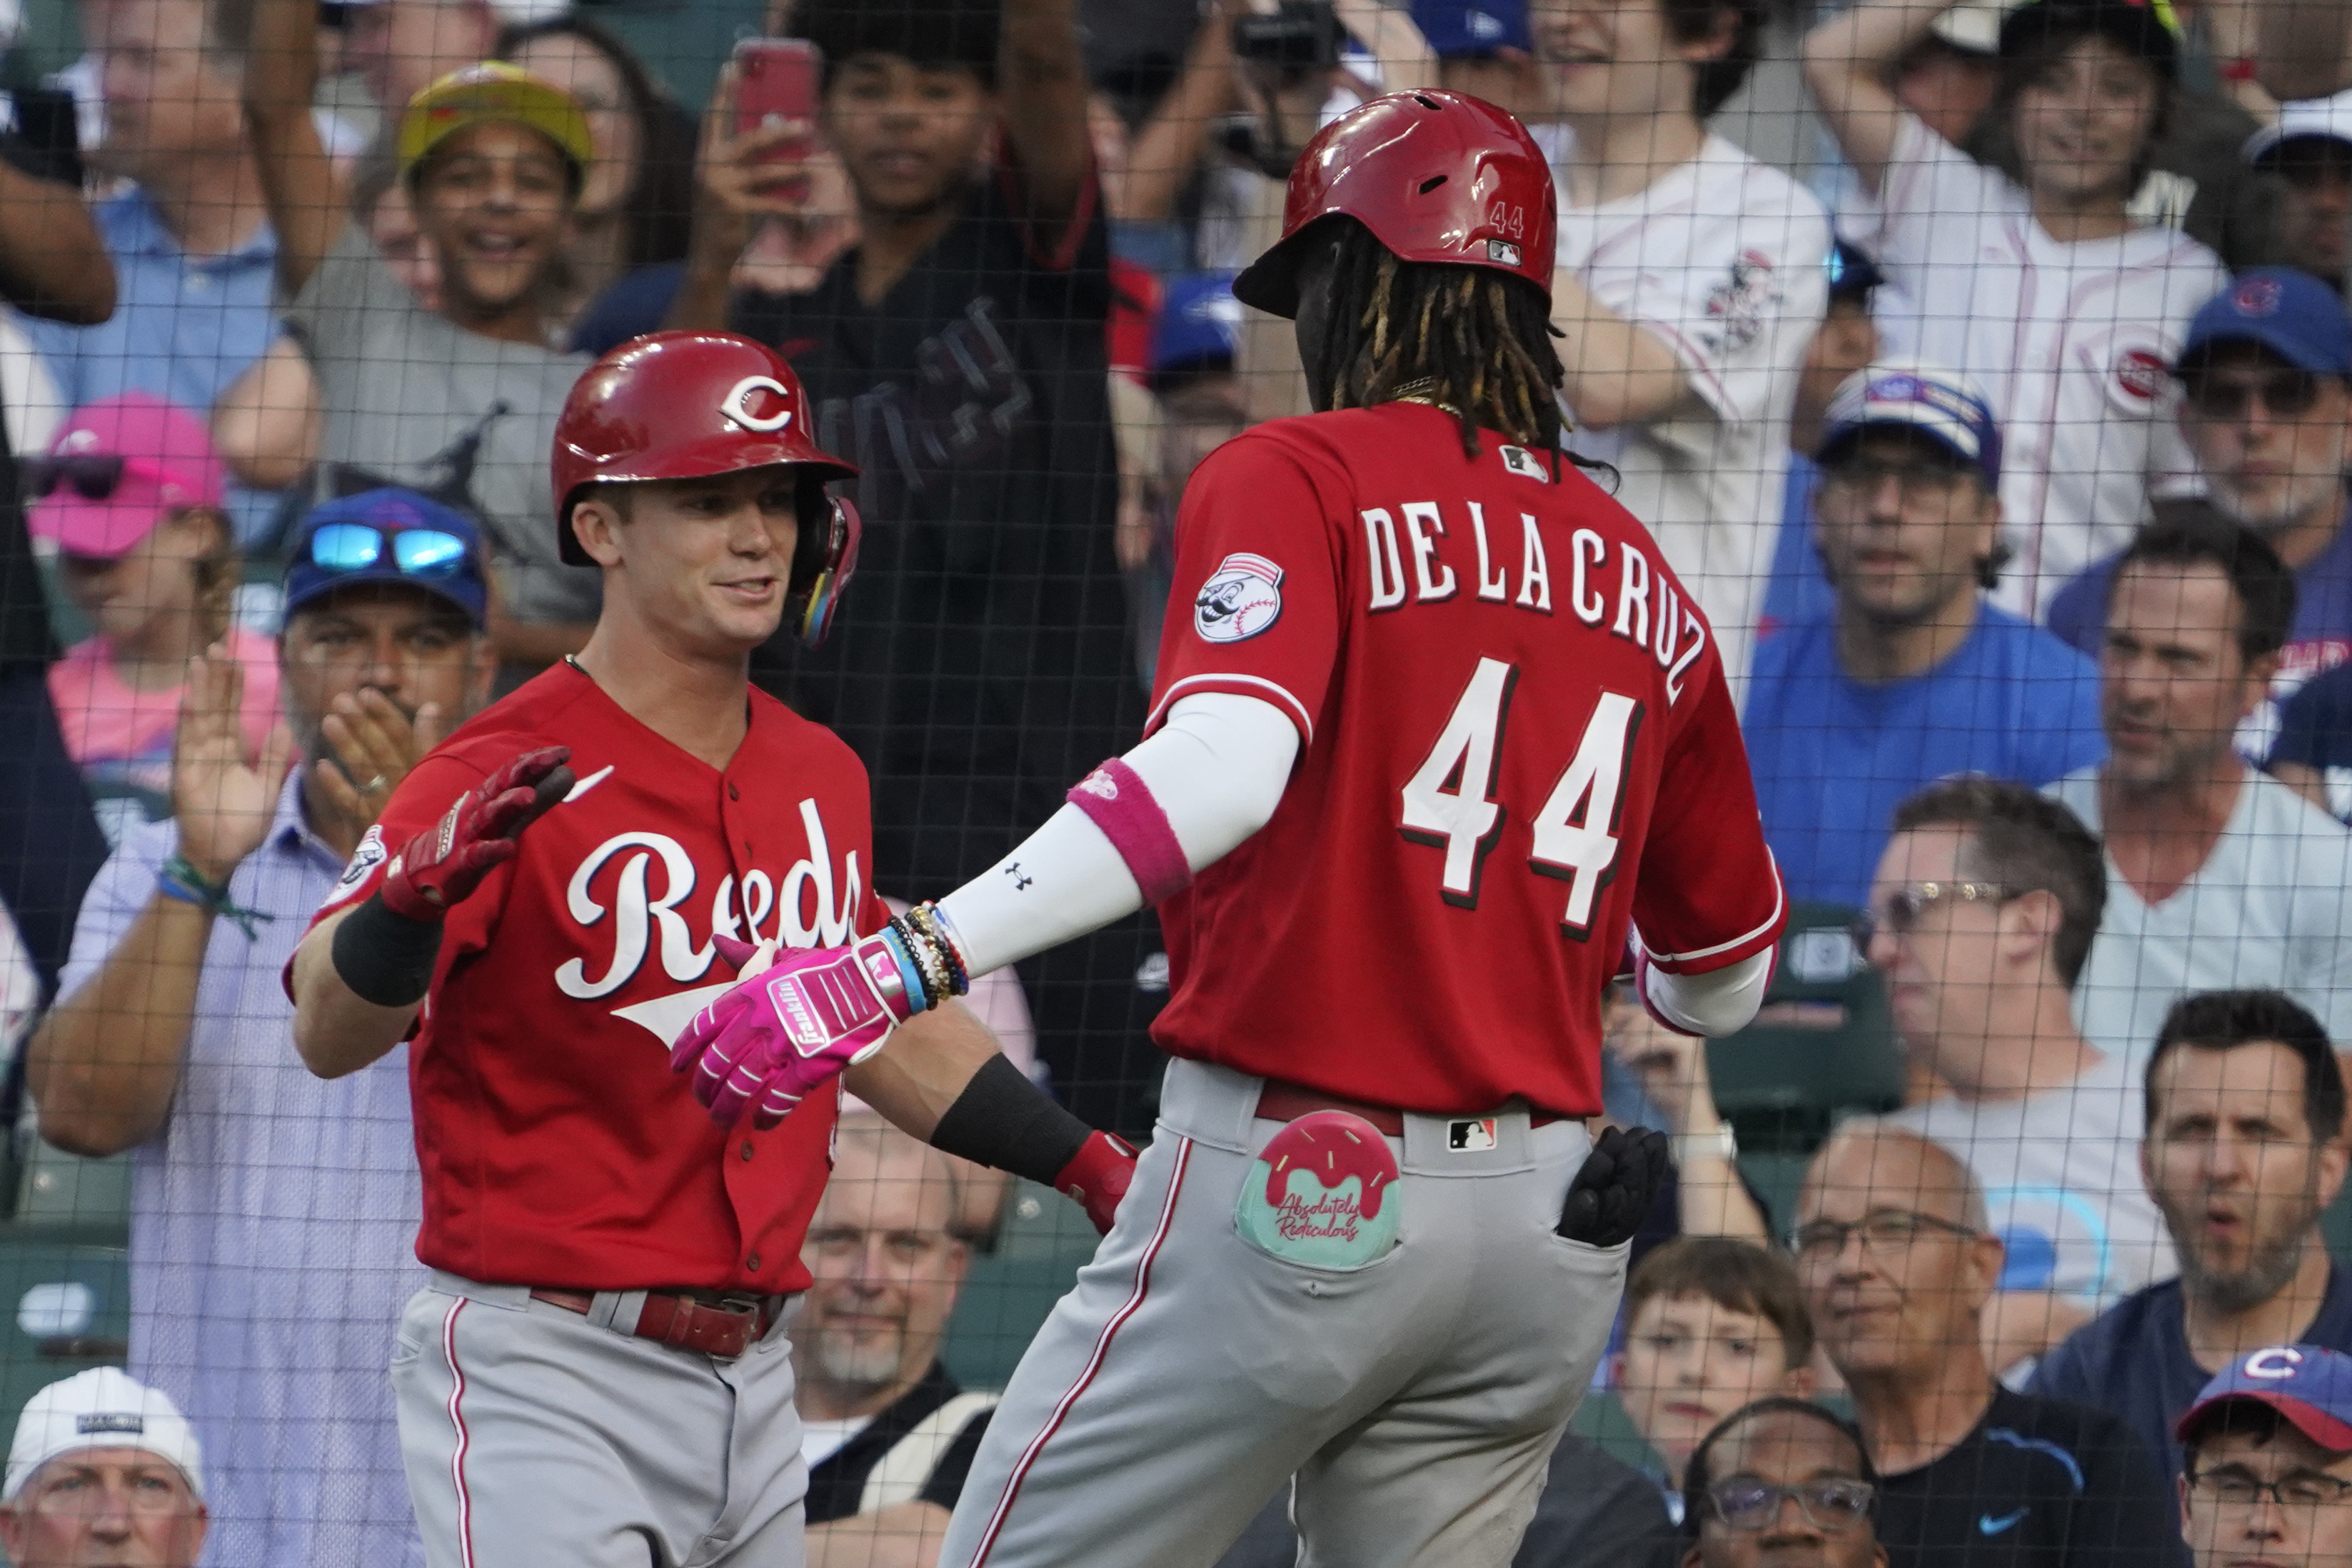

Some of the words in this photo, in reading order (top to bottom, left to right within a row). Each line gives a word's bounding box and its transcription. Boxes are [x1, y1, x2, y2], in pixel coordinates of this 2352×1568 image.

[1489, 201, 1524, 238] 44
[720, 375, 793, 433] C
[1360, 501, 1459, 615] DE
[1467, 501, 1554, 615] LA
[1572, 528, 1707, 708] CRUZ
[1397, 653, 1645, 943] 44
[554, 797, 862, 1000] Reds
[1275, 1216, 1359, 1242] Ridiculous
[1277, 1192, 1360, 1227] Absolutely
[2244, 1347, 2303, 1379] C
